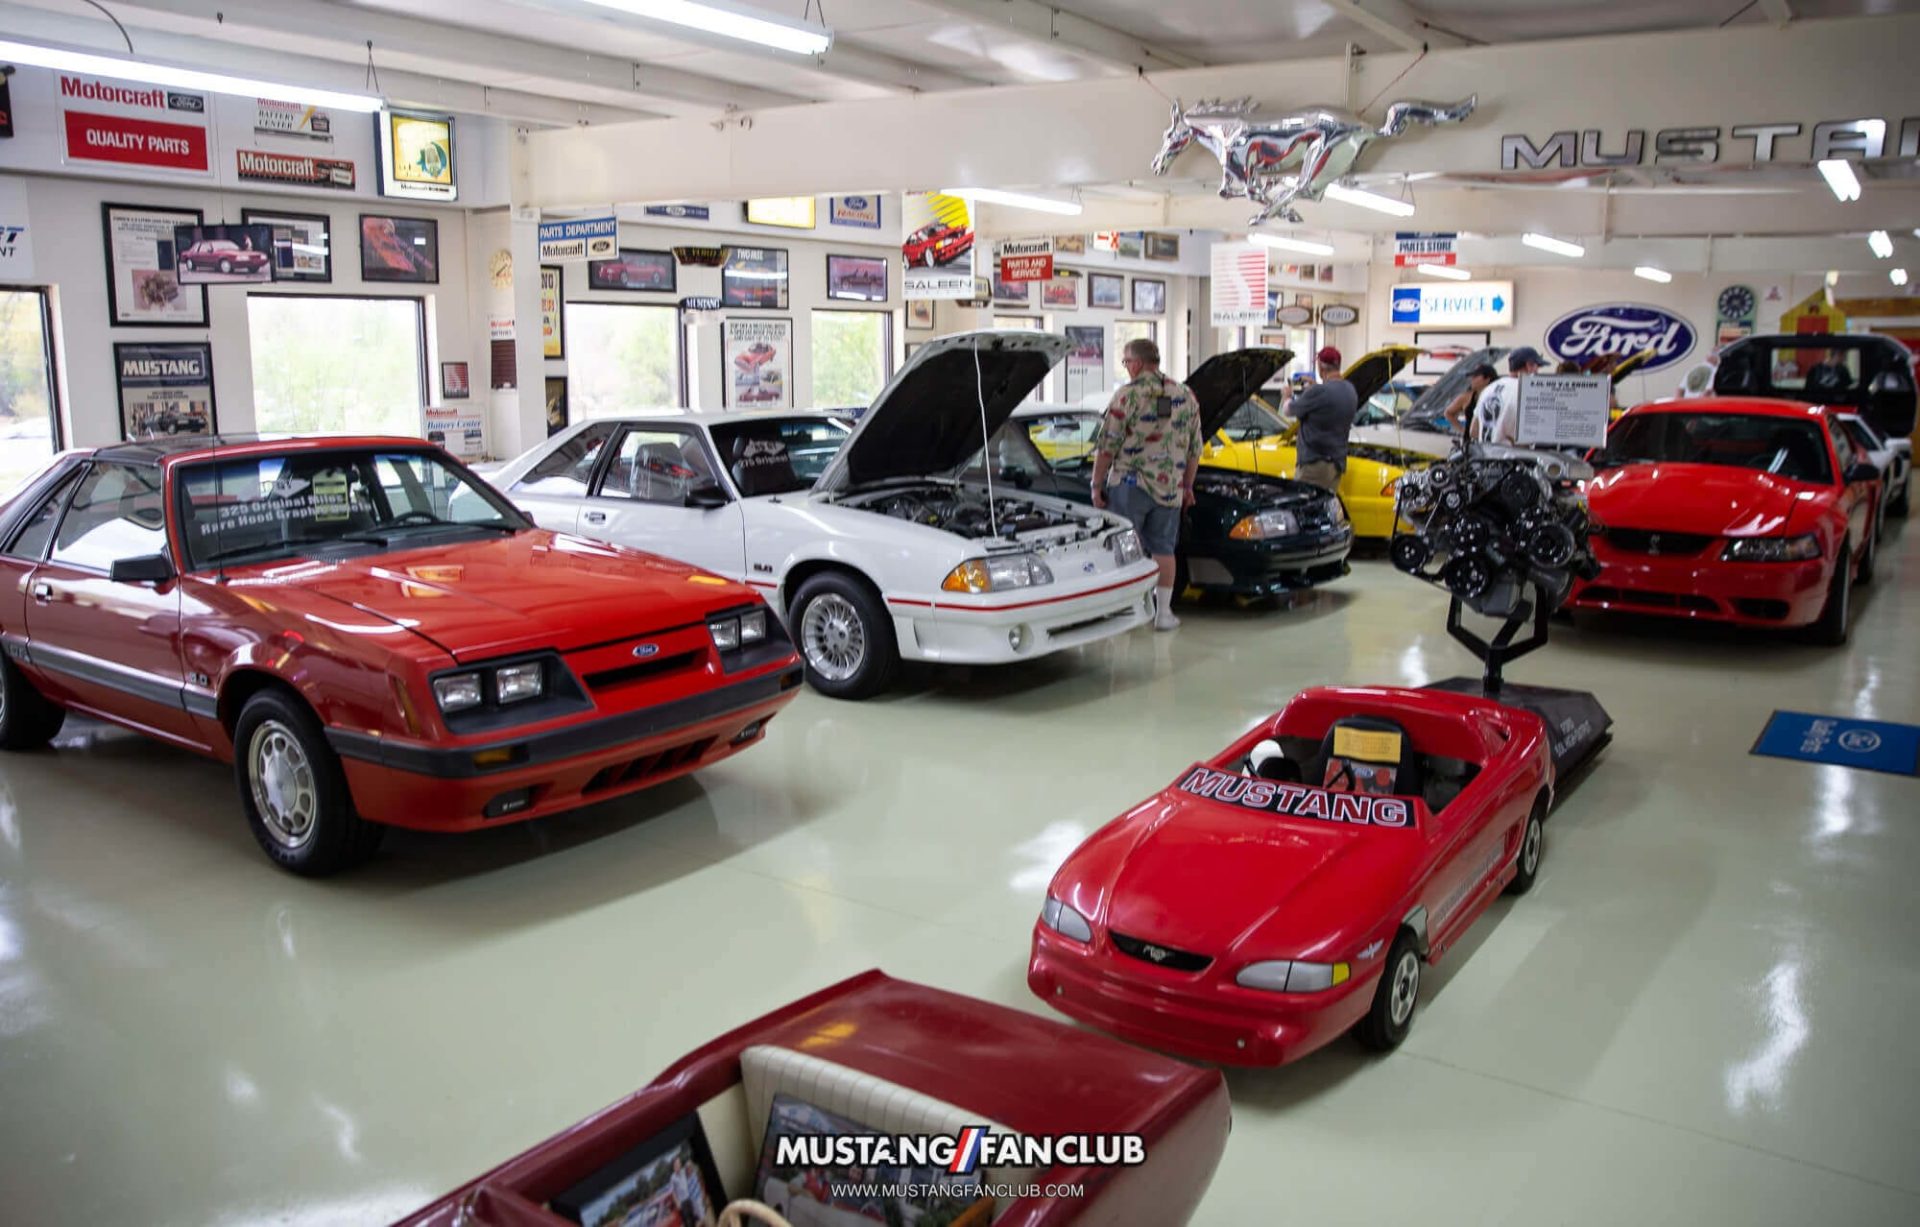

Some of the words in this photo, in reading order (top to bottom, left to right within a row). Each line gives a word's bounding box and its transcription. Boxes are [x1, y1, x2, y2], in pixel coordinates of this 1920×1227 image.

[61, 76, 165, 108] Motorcraft
[259, 110, 294, 121] BATTERY
[259, 119, 292, 130] CENTER
[86, 128, 146, 151] QUALITY
[147, 136, 190, 155] PARTS
[239, 152, 315, 177] Motorcraft
[540, 225, 563, 239] PARTS
[566, 220, 615, 236] DEPARTMENT
[542, 242, 583, 257] Motorcraft
[1003, 242, 1049, 254] Motorcraft
[1399, 241, 1425, 253] PARTS
[1427, 240, 1452, 252] STORE
[1007, 259, 1030, 270] PARTS
[1031, 257, 1047, 268] AND
[1012, 269, 1041, 279] SERVICE
[904, 280, 972, 289] SALEEN
[685, 297, 721, 309] MUSTANG
[1425, 296, 1487, 312] SERVICE
[1560, 315, 1681, 357] Ford
[122, 359, 200, 376] MUSTANG
[426, 409, 458, 417] Motorcraft
[428, 421, 456, 430] Battery
[457, 420, 481, 429] Center
[755, 454, 788, 465] Original
[220, 504, 248, 519] 325
[251, 495, 306, 512] Original
[308, 493, 343, 505] Miles
[201, 518, 235, 536] Rare
[238, 512, 273, 528] Hood
[1180, 767, 1407, 826] MUSTANG
